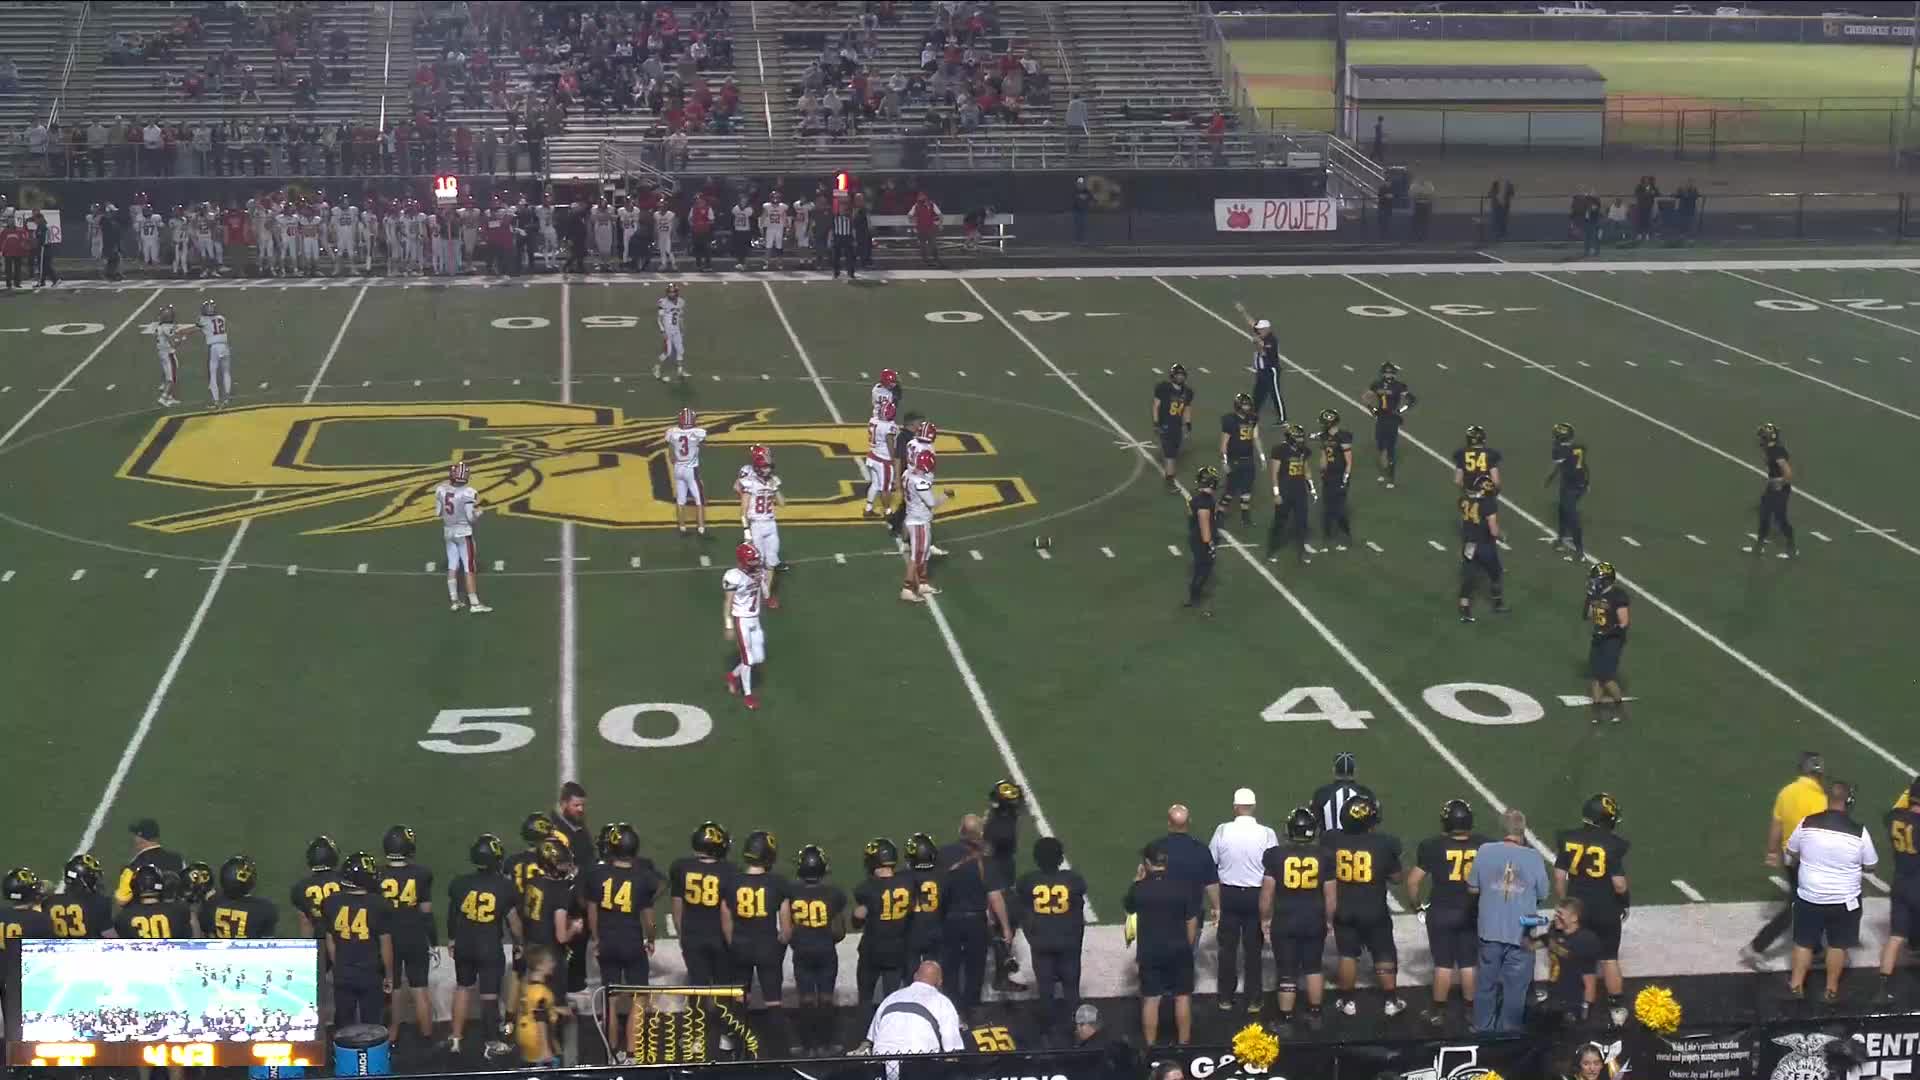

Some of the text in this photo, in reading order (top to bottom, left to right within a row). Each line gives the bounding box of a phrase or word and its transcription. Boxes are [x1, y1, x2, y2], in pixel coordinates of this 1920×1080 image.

[1262, 200, 1330, 230] POWER
[211, 319, 225, 335] 12
[678, 435, 689, 456] 3
[1573, 448, 1583, 468] 7
[1464, 452, 1488, 472] 54
[445, 492, 455, 515] 5
[755, 496, 773, 514] 82
[1284, 856, 1319, 890] 62
[1336, 851, 1372, 883] 68
[1565, 843, 1607, 878] 73
[602, 877, 632, 912] 14
[685, 872, 719, 906] 58
[736, 887, 767, 918] 81
[880, 887, 910, 921] 12
[1032, 884, 1069, 914] 23
[50, 904, 86, 937] 63
[461, 890, 496, 922] 42
[792, 900, 827, 928] 20
[131, 914, 171, 938] 30
[215, 907, 248, 938] 57
[334, 905, 370, 940] 44
[972, 1026, 1016, 1052] 55
